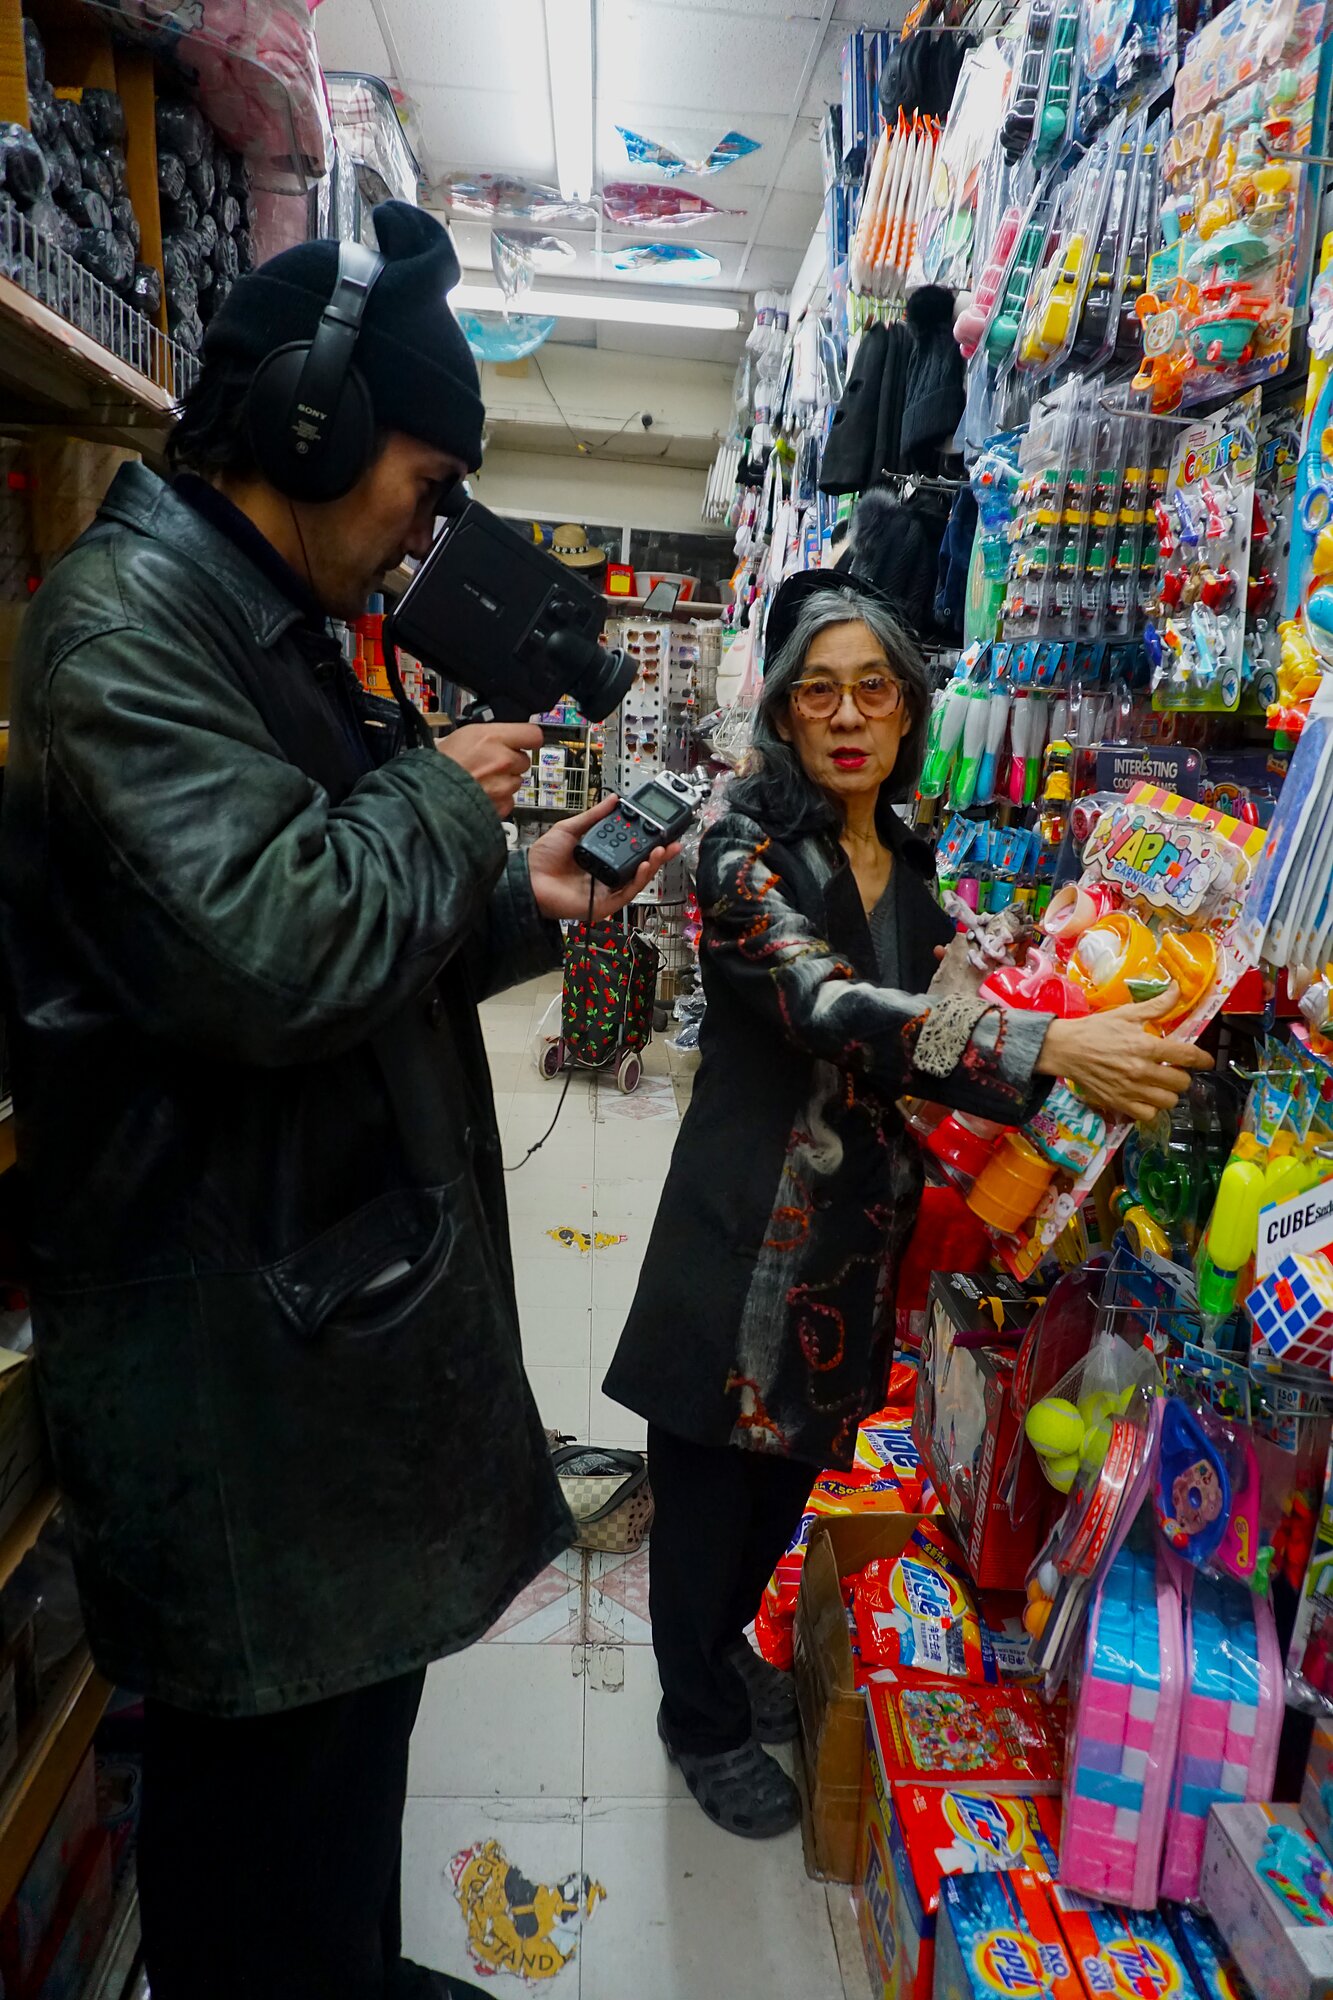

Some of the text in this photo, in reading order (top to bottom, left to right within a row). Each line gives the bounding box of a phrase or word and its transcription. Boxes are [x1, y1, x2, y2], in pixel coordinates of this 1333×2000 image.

[297, 403, 328, 420] SONY
[1114, 758, 1178, 779] INTERESTING
[1186, 758, 1196, 768] 3+
[1105, 815, 1201, 894] HAPPY
[1113, 861, 1157, 893] CARNIVAL
[1267, 1203, 1316, 1244] CUBE
[969, 1433, 995, 1570] TRANSMUTES
[901, 1558, 950, 1618] Tide
[995, 1937, 1043, 1990] Tide
[1044, 1945, 1069, 1977] OXI
[1083, 1957, 1108, 1991] OXI
